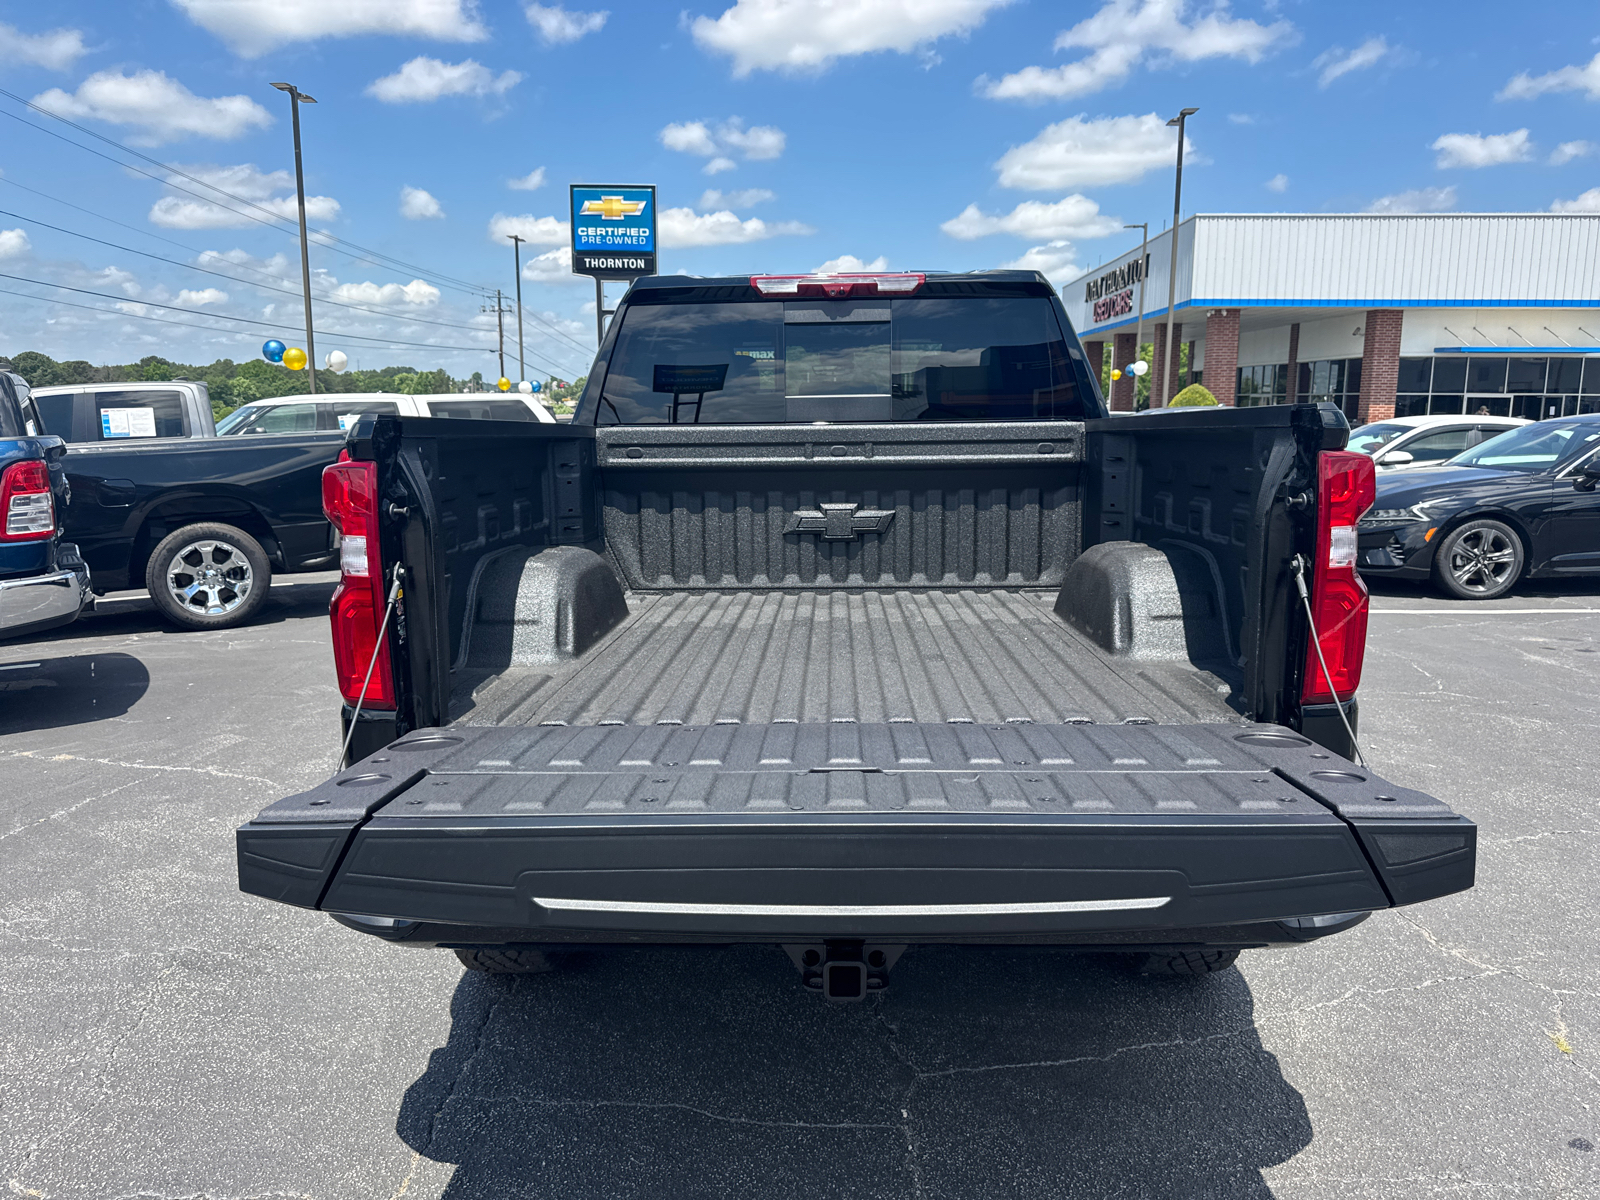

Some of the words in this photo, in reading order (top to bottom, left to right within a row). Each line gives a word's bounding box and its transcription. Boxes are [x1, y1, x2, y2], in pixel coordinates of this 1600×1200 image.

[578, 227, 649, 236] CERTIFIED
[581, 236, 646, 245] PRE-OWNED
[584, 258, 645, 269] THORNTON
[1093, 297, 1111, 323] USED
[1111, 289, 1133, 317] CARS
